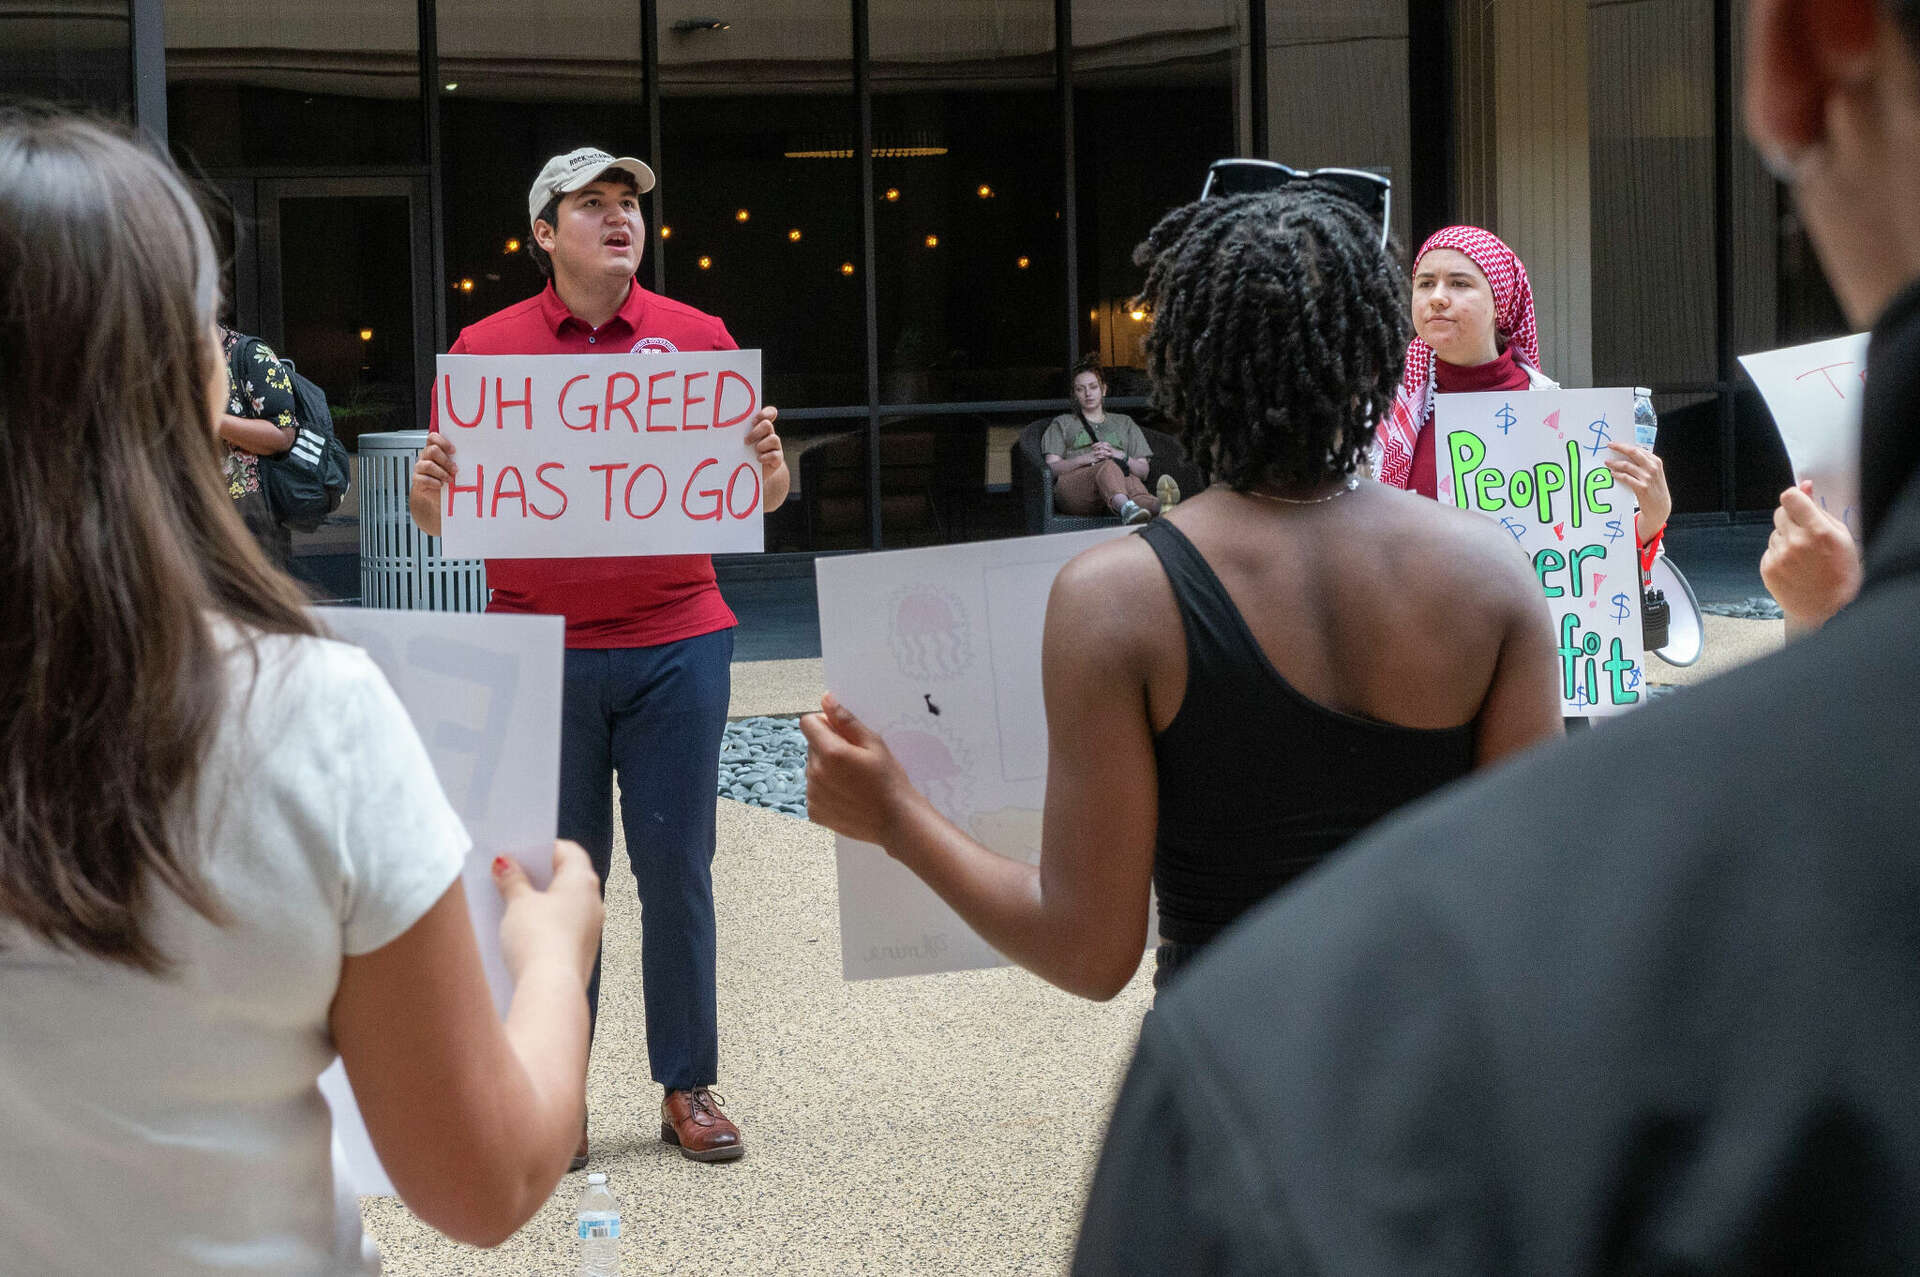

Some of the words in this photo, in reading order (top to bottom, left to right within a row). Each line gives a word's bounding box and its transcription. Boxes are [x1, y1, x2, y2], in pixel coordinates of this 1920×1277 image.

[445, 374, 533, 430] UH
[558, 370, 757, 433] GREED
[447, 462, 568, 521] HAS
[589, 463, 668, 521] TO
[681, 458, 760, 521] GO
[1448, 430, 1615, 528] People
[1525, 544, 1608, 598] er
[1557, 612, 1640, 705] fit
